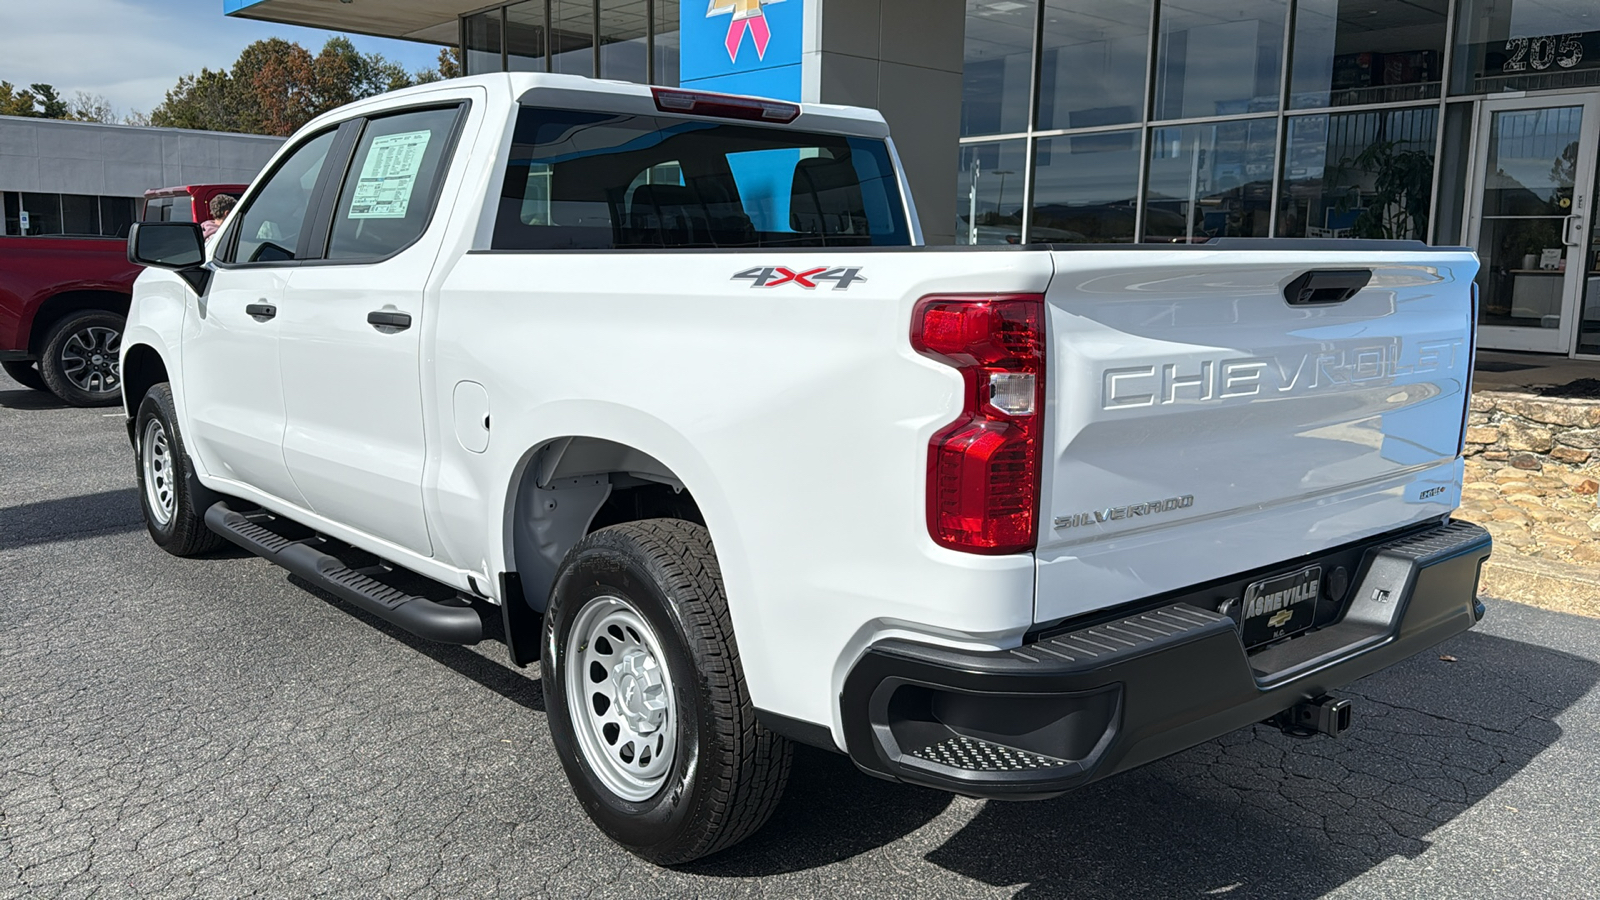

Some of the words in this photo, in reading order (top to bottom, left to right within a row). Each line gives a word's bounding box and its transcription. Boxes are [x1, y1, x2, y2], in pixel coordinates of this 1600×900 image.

[1502, 33, 1584, 72] 205
[1102, 337, 1463, 410] CHEVROLET
[1053, 494, 1195, 530] SILVERADO
[1245, 580, 1319, 619] ASHEVILLE
